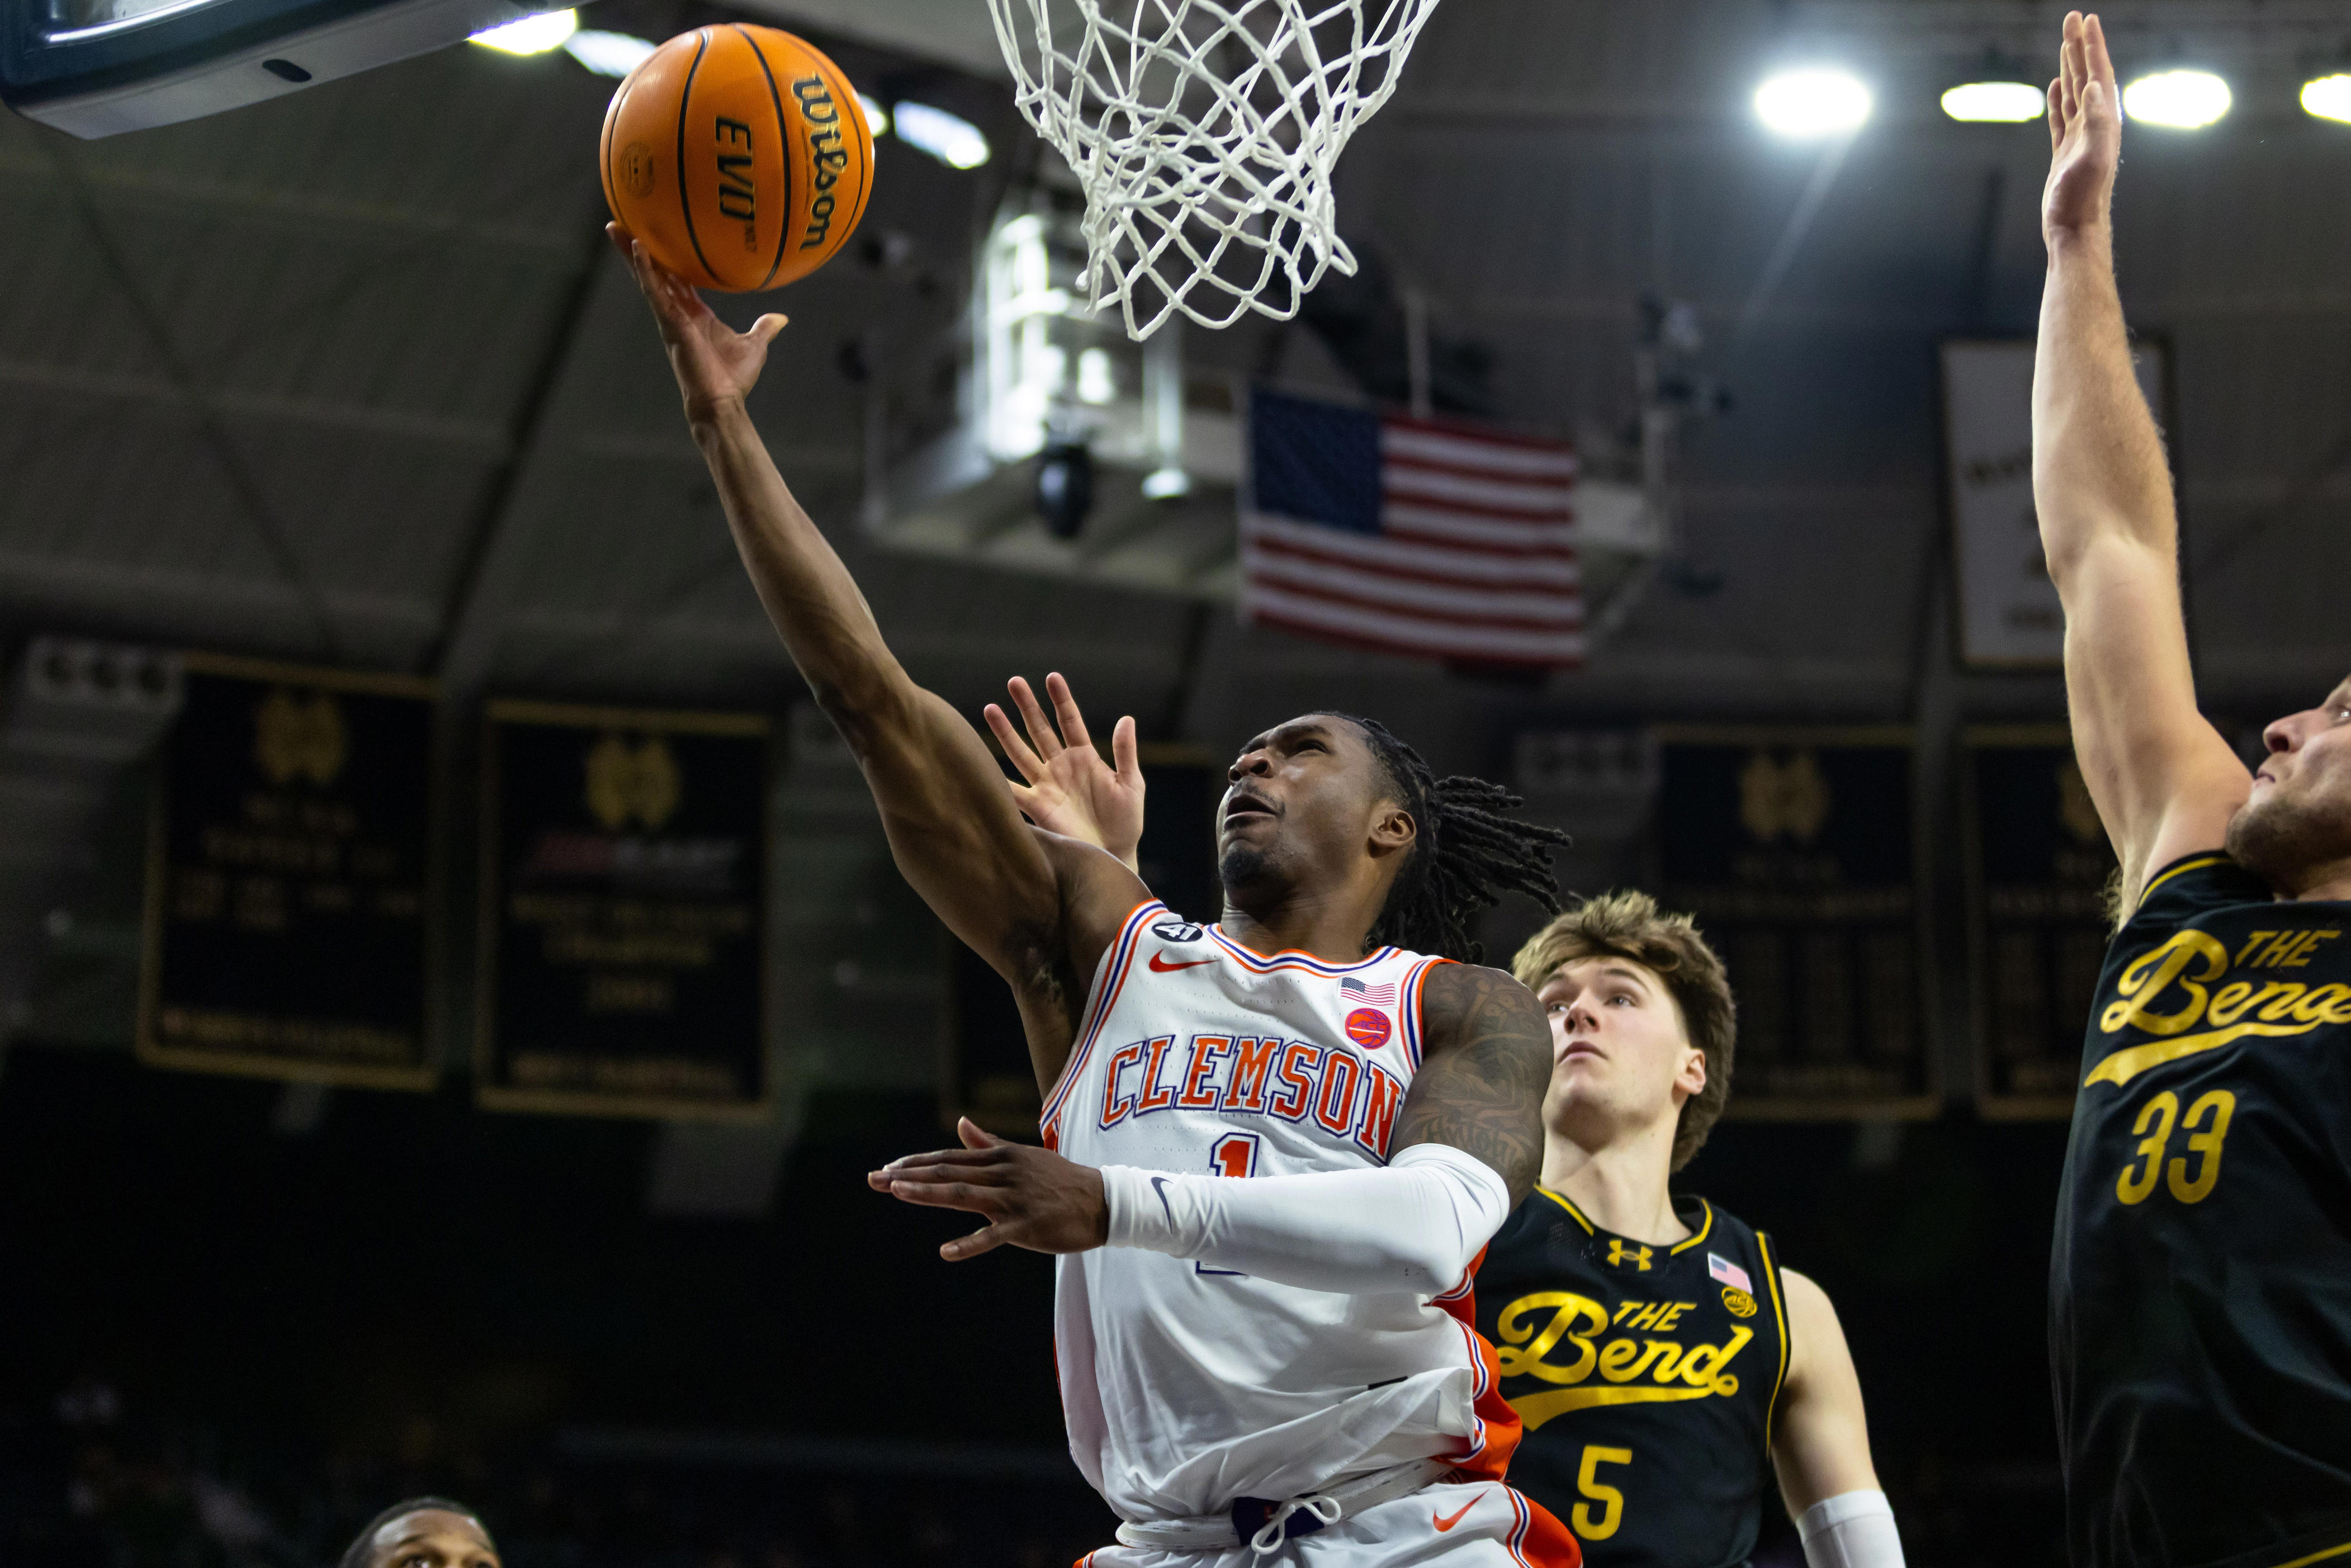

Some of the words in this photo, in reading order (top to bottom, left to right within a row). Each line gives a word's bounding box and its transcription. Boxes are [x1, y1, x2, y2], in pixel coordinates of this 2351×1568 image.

[715, 116, 756, 221] EVO
[791, 71, 848, 252] Wilson
[1155, 923, 1198, 941] 41
[2234, 929, 2342, 969] THE
[1352, 1019, 1388, 1031] ACC
[1098, 1034, 1406, 1164] CLEMSON
[2116, 1088, 2237, 1206] 33
[1497, 1291, 1754, 1397] Bend
[1612, 1300, 1697, 1332] THE
[1570, 1444, 1633, 1542] 5
